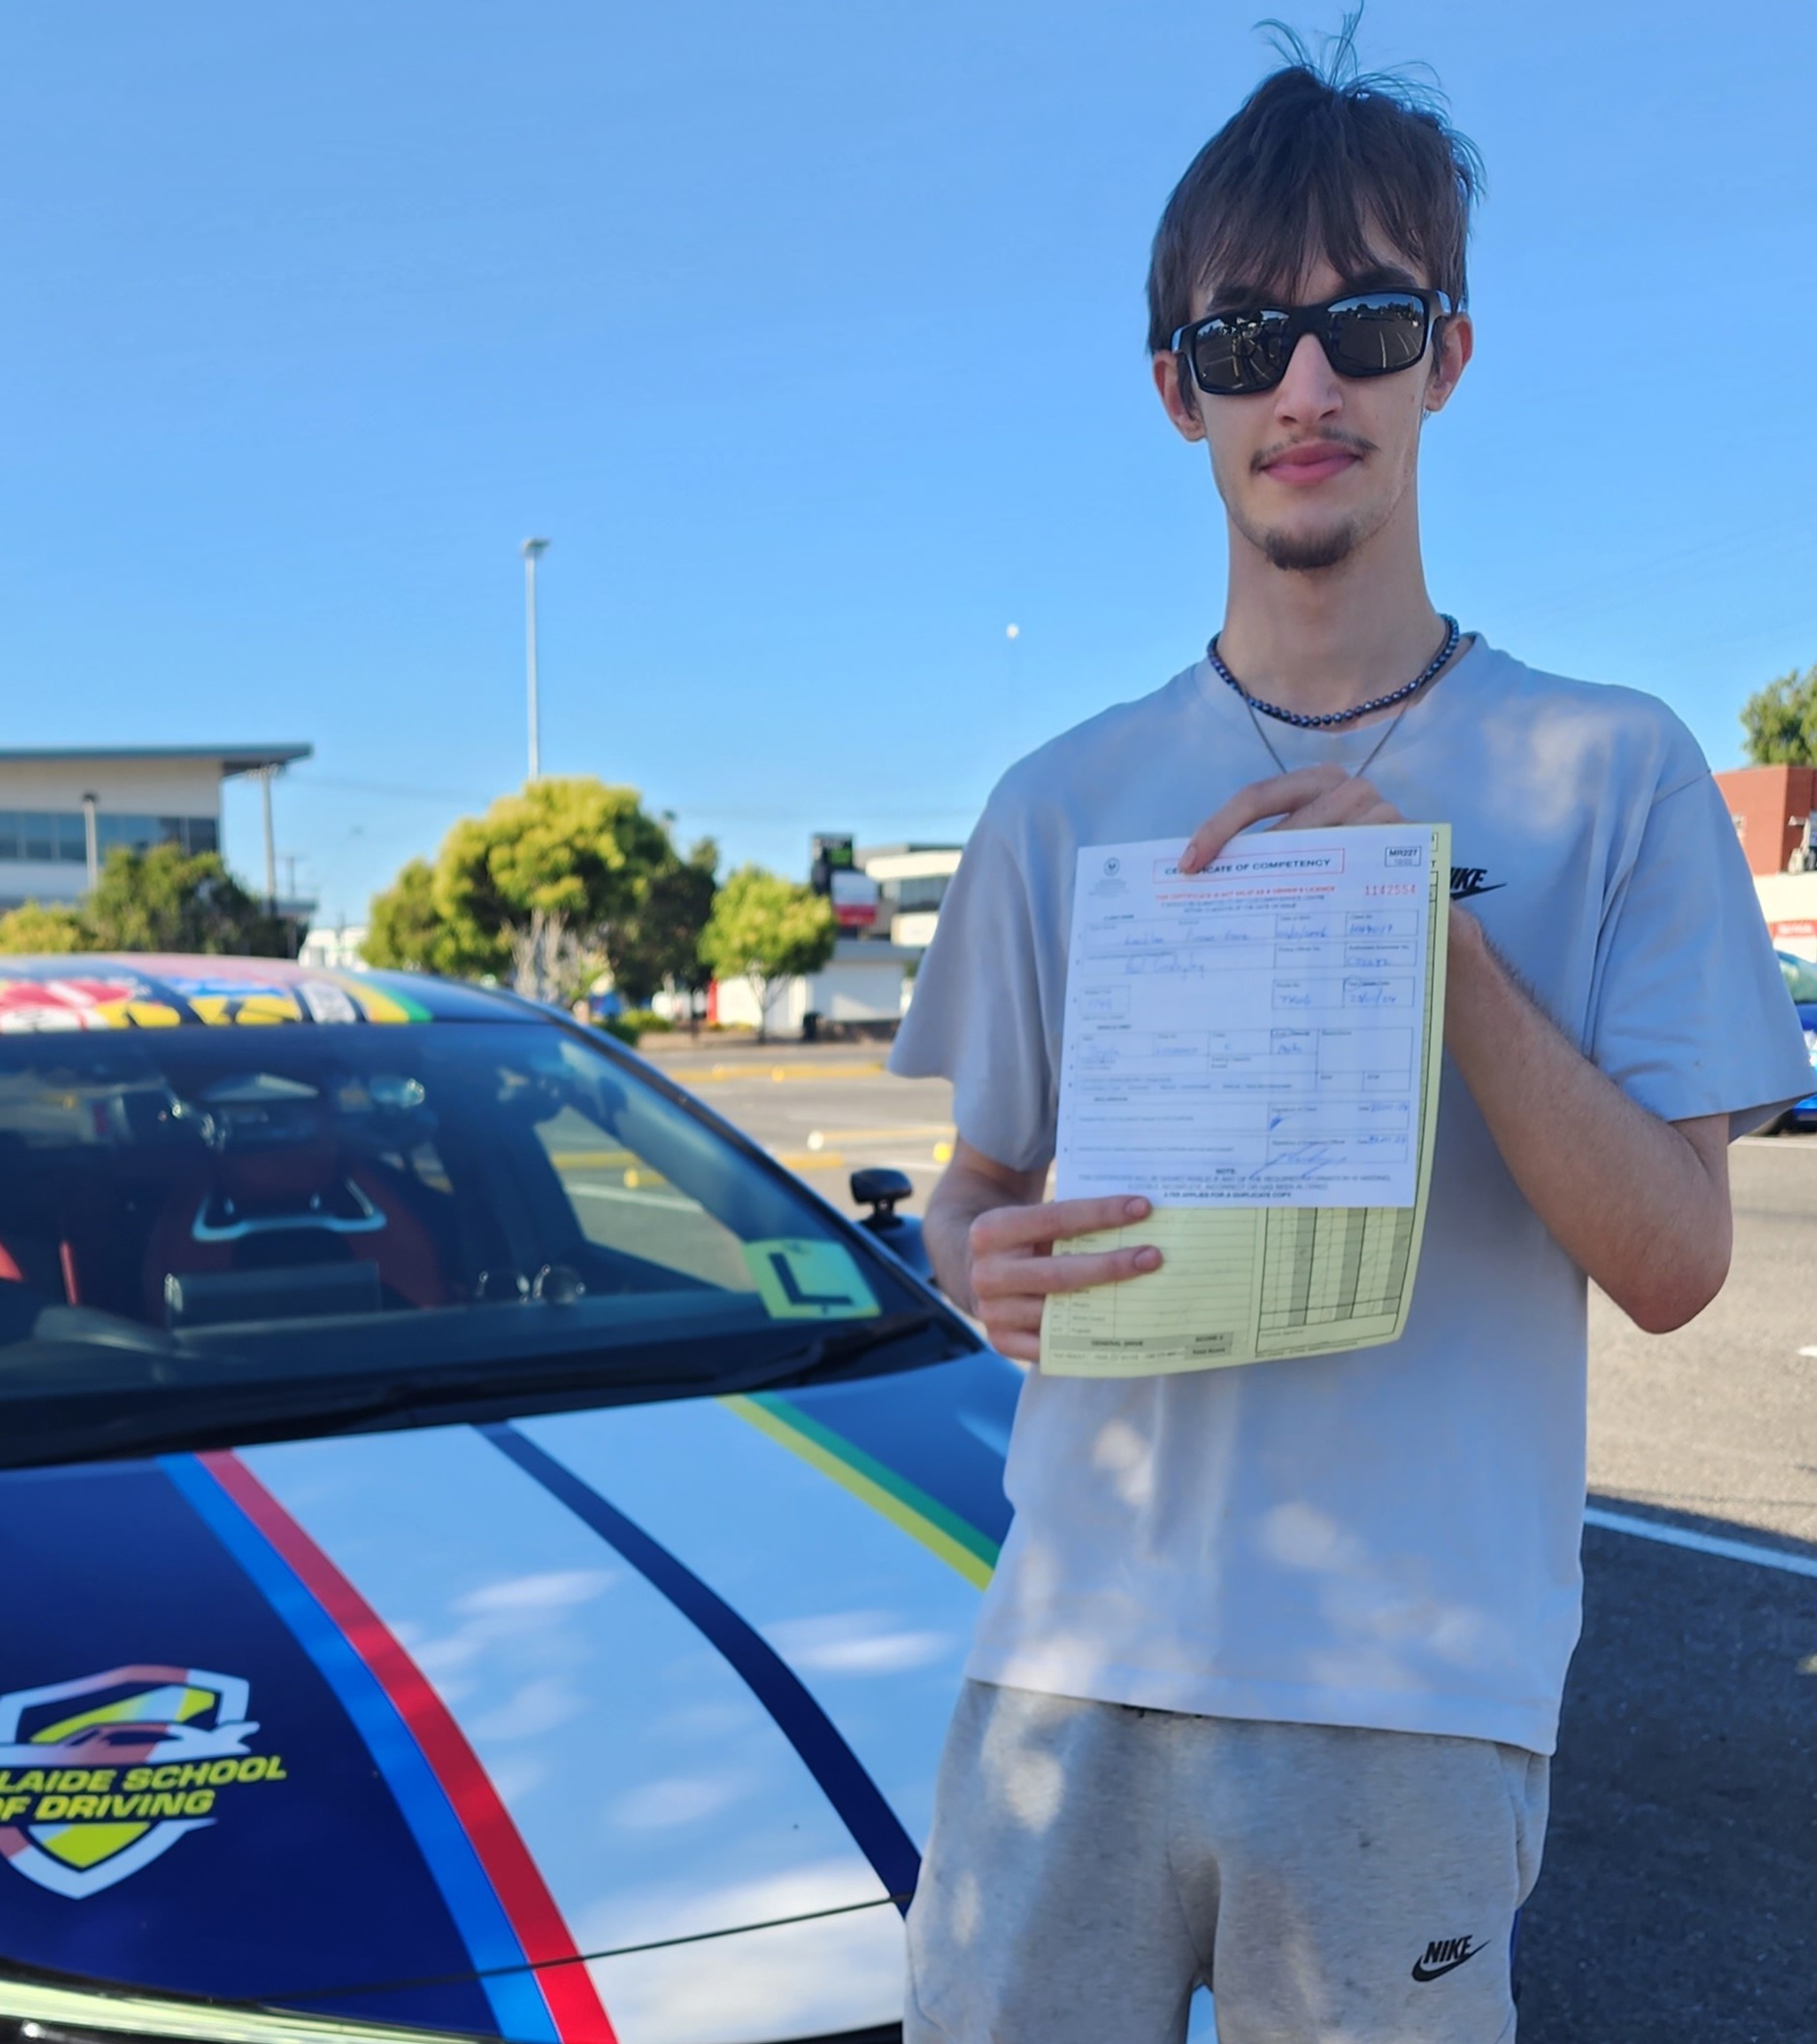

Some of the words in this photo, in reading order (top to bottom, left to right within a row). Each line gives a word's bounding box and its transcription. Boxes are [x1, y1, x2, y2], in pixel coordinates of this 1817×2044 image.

[1164, 865, 1233, 875] CEICATE
[1253, 859, 1331, 870] COMPETENCY
[1364, 884, 1417, 896] 1142554
[767, 1253, 855, 1306] L
[122, 1755, 287, 1791] SCHOOL
[35, 1789, 216, 1821] DRIVING
[1423, 1934, 1473, 1964] NIKE
